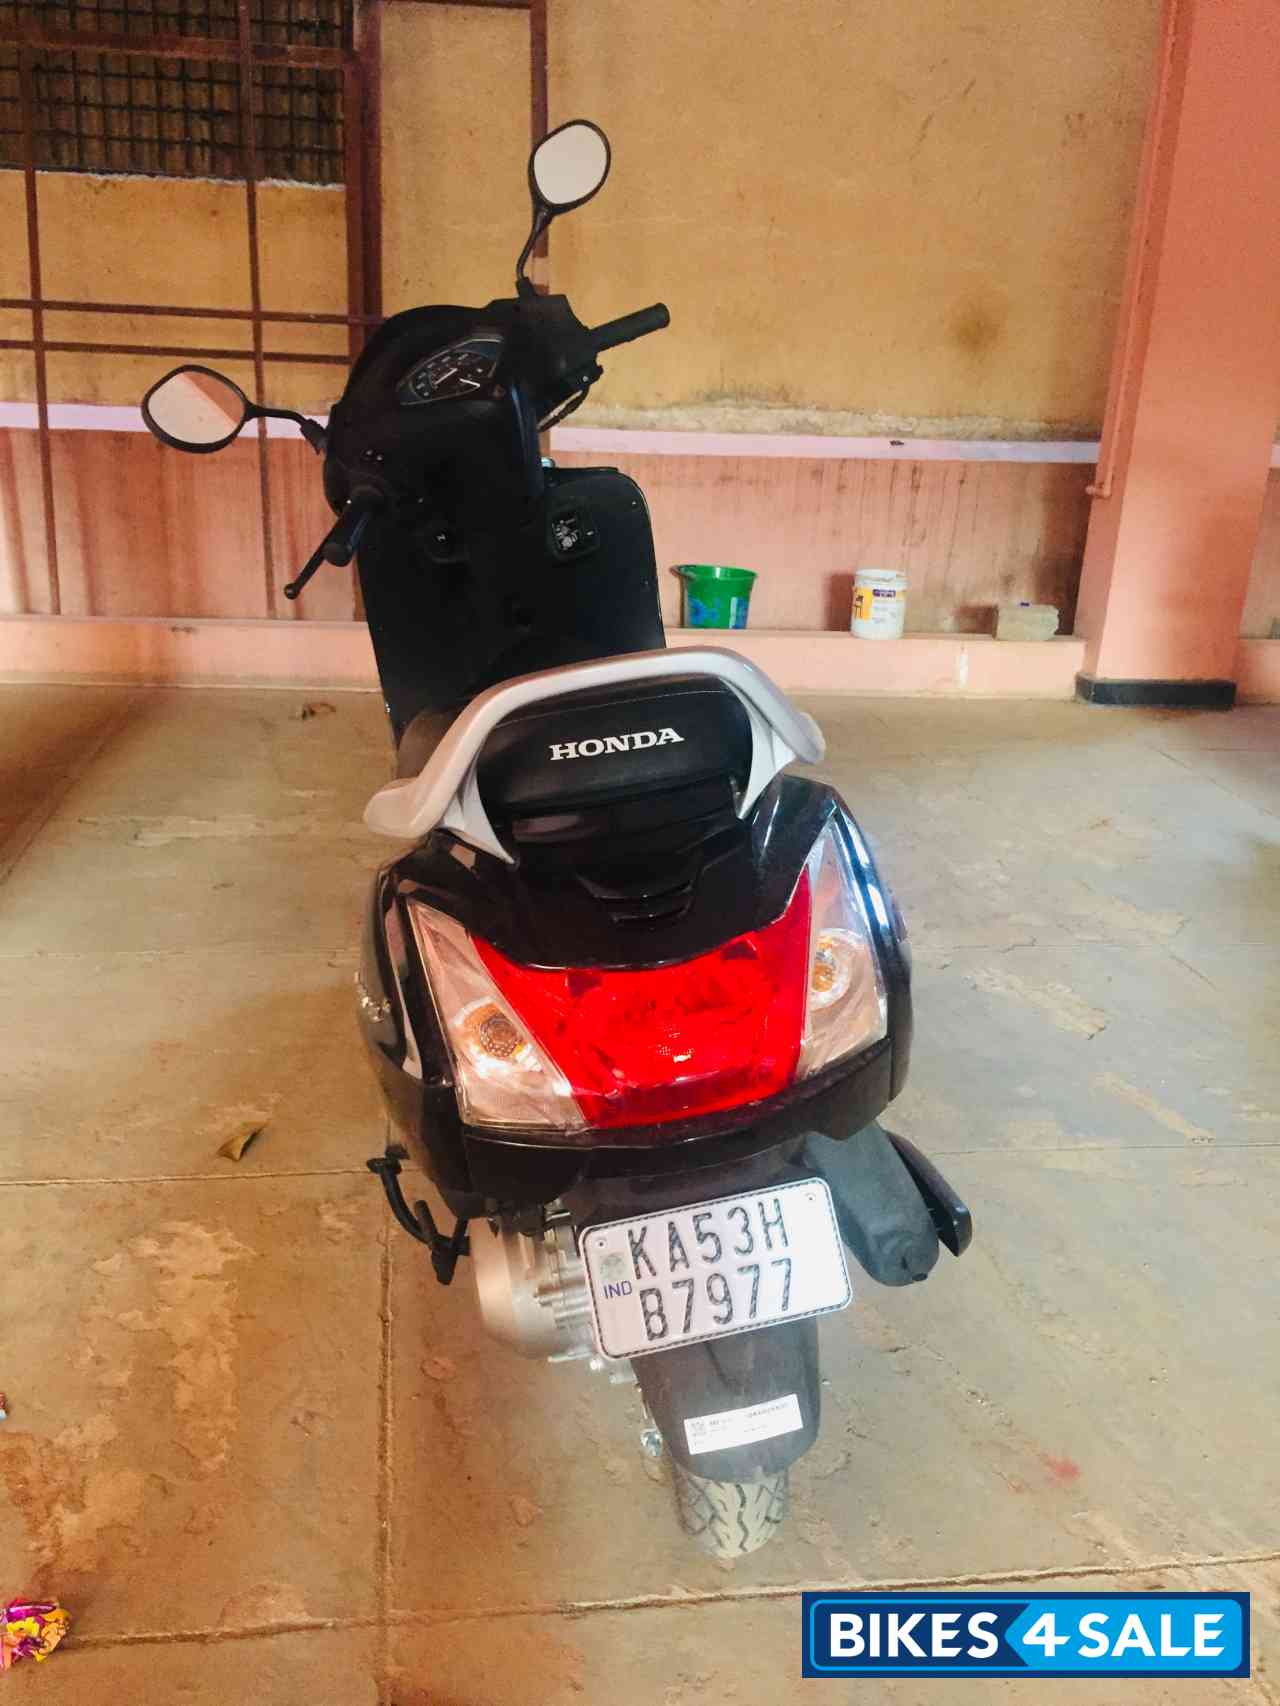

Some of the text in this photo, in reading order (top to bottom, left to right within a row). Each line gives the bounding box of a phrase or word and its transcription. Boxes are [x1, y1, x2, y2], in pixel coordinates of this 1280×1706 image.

[549, 727, 685, 761] HONDA
[627, 1198, 790, 1280] KA53H
[603, 1280, 633, 1299] IND
[639, 1257, 792, 1341] B7977
